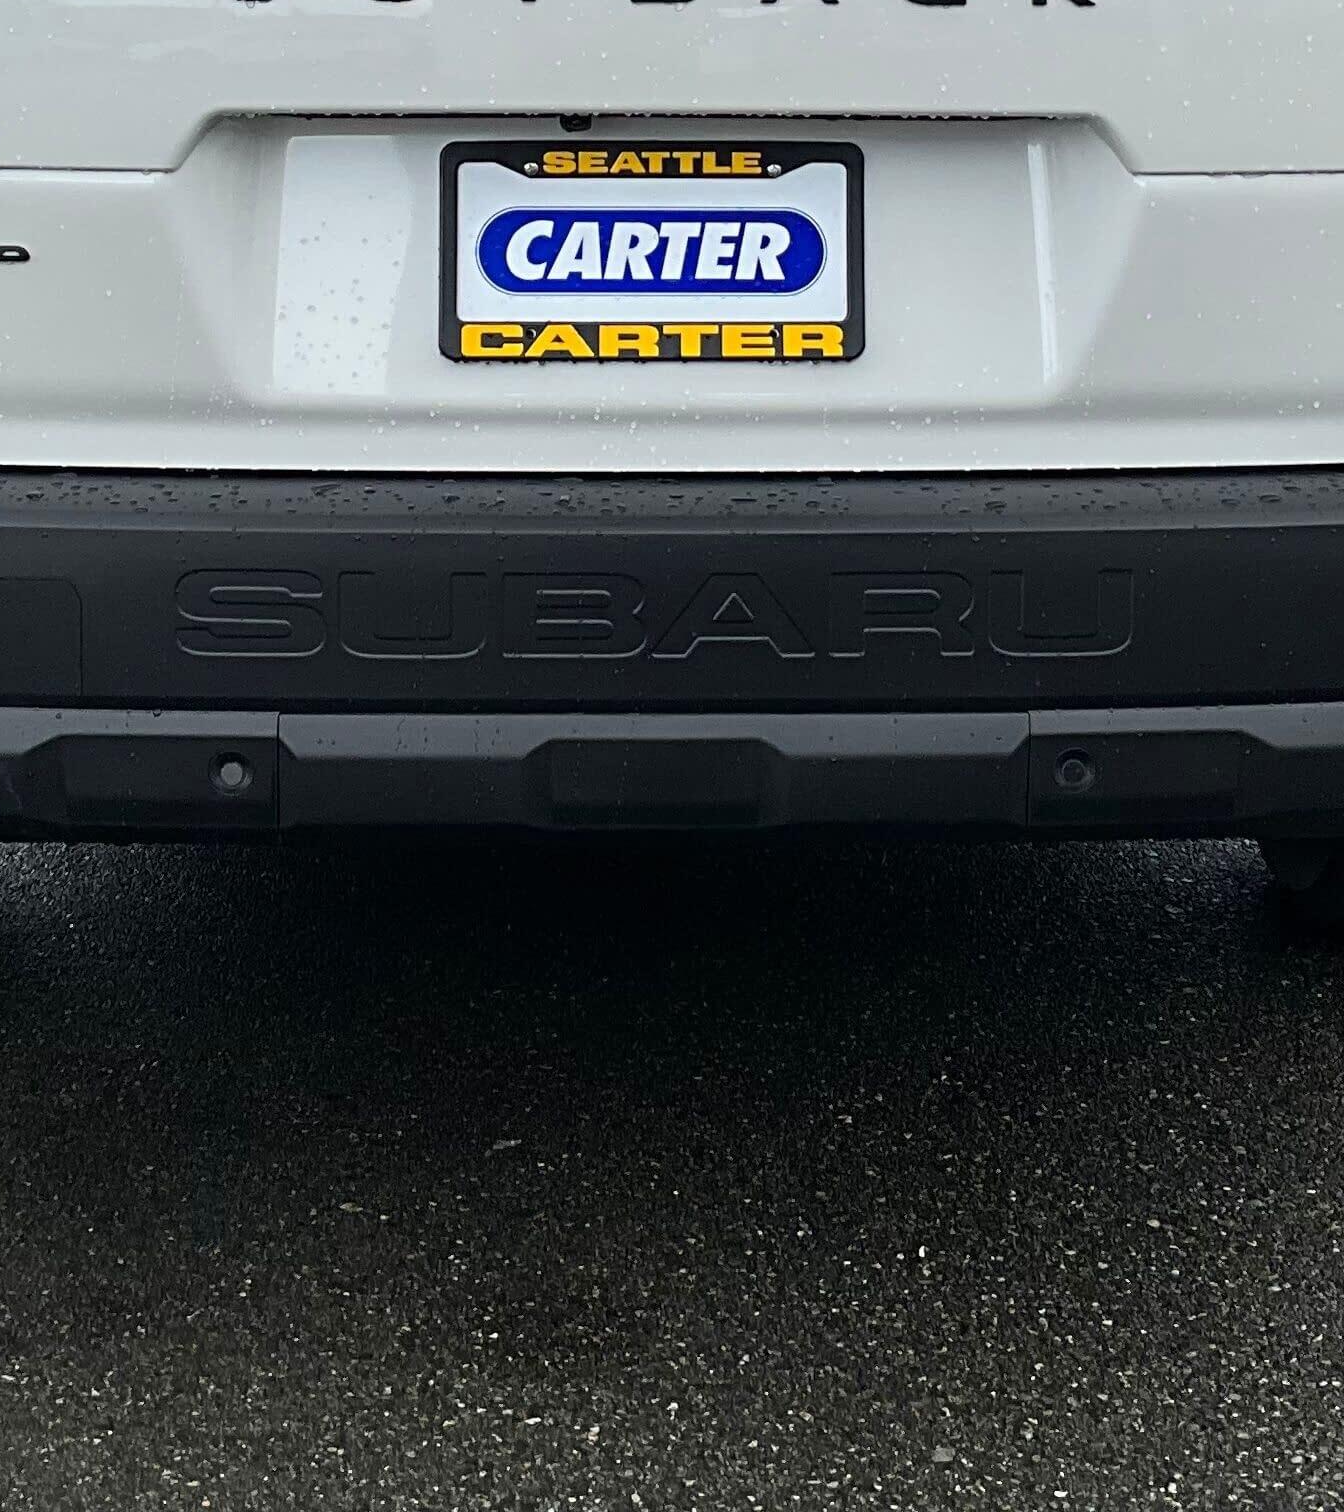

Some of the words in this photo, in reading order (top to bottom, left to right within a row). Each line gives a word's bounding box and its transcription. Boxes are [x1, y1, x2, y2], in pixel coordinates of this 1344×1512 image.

[542, 151, 763, 175] SEATTLE
[505, 219, 792, 281] CARTER
[460, 323, 844, 358] CARTER
[174, 568, 1134, 659] SUBARU
